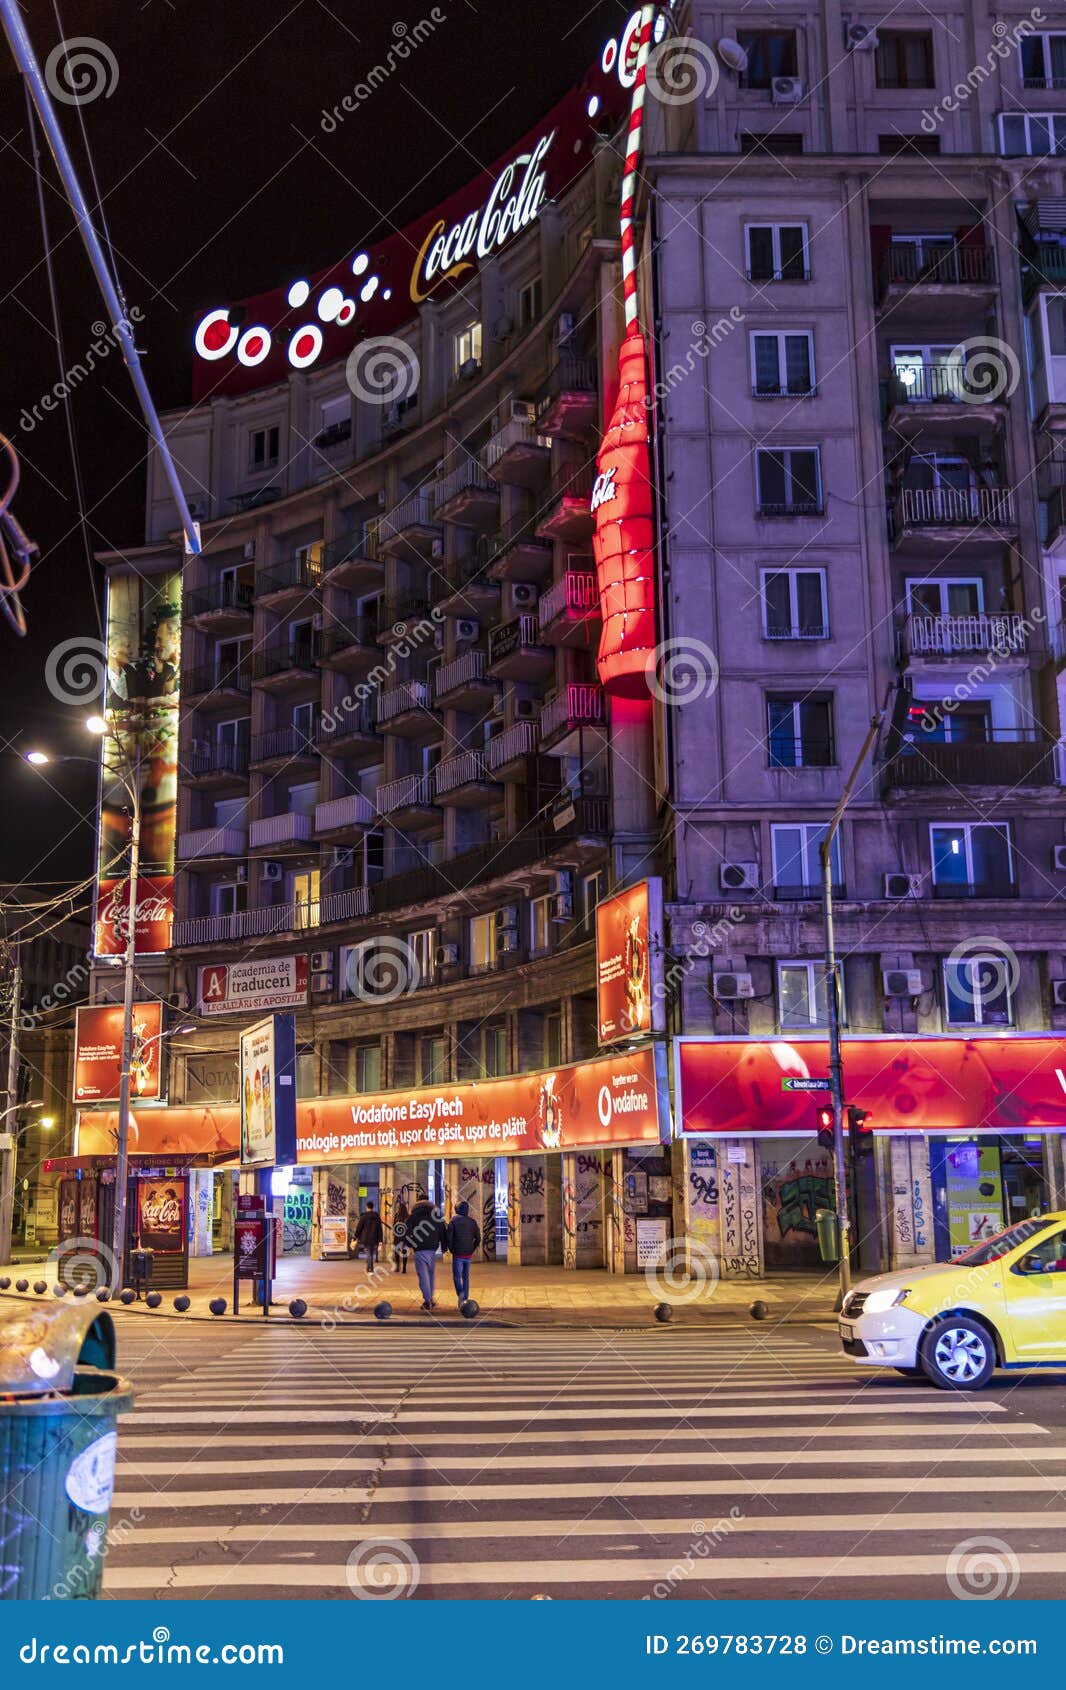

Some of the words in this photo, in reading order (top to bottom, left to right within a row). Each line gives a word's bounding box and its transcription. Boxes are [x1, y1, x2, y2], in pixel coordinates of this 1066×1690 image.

[232, 966, 276, 979] academia
[278, 962, 291, 973] de
[232, 974, 291, 993] traduceri
[264, 993, 305, 1005] APOSTILE
[351, 1104, 407, 1124] Vodafone
[409, 1096, 463, 1123] EasyTech
[612, 1088, 648, 1114] vodafone
[340, 1131, 376, 1151] pentru
[424, 1125, 436, 1141] de
[488, 1120, 501, 1136] de
